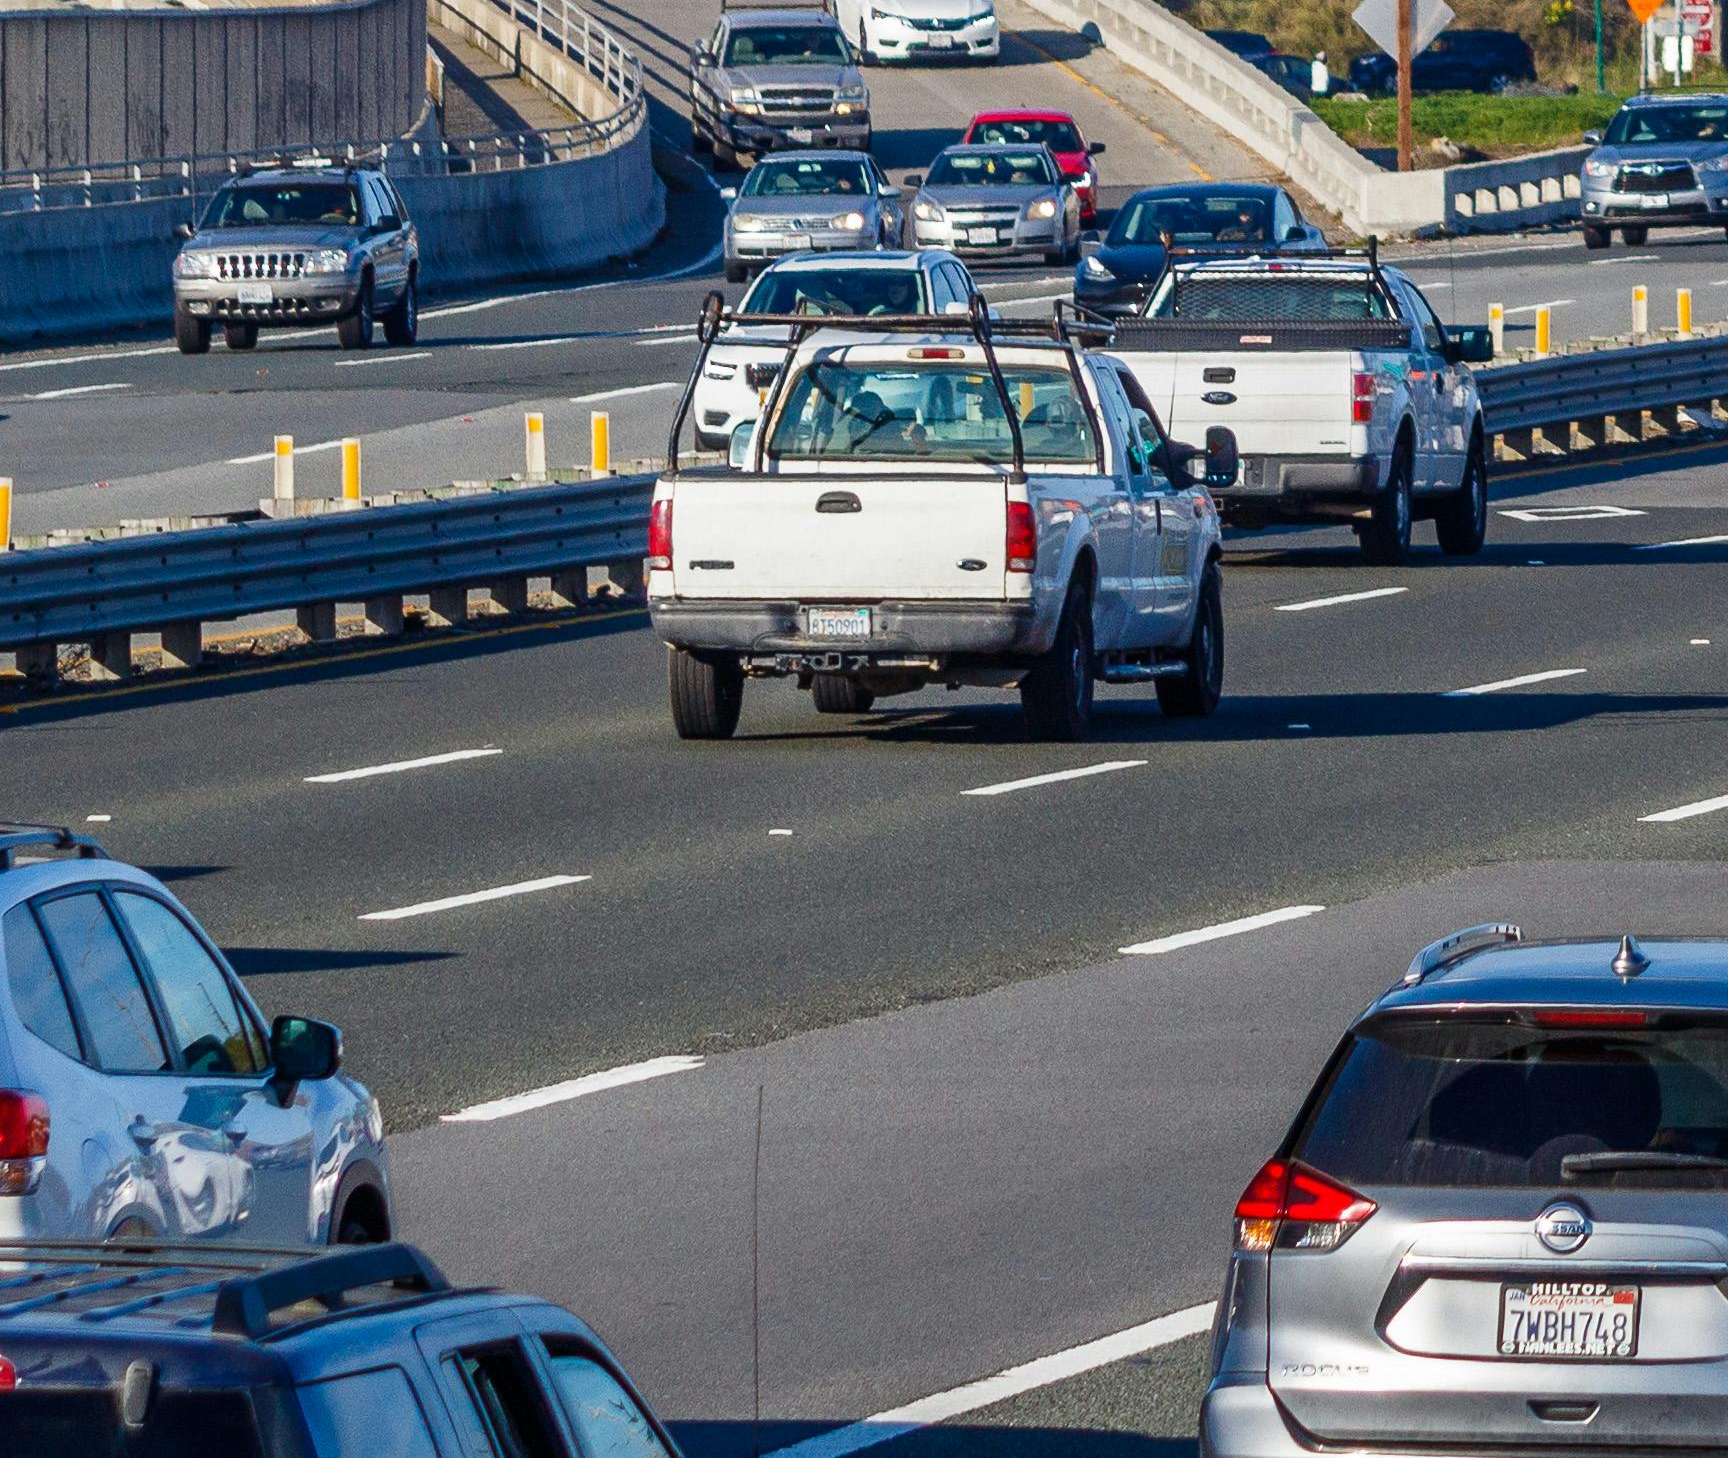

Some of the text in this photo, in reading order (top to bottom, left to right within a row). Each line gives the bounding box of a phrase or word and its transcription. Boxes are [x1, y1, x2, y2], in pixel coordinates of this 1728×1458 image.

[1531, 1283, 1607, 1296] HILLTOP
[1509, 1291, 1613, 1311] JAN California
[1510, 1310, 1628, 1343] 7WBH748
